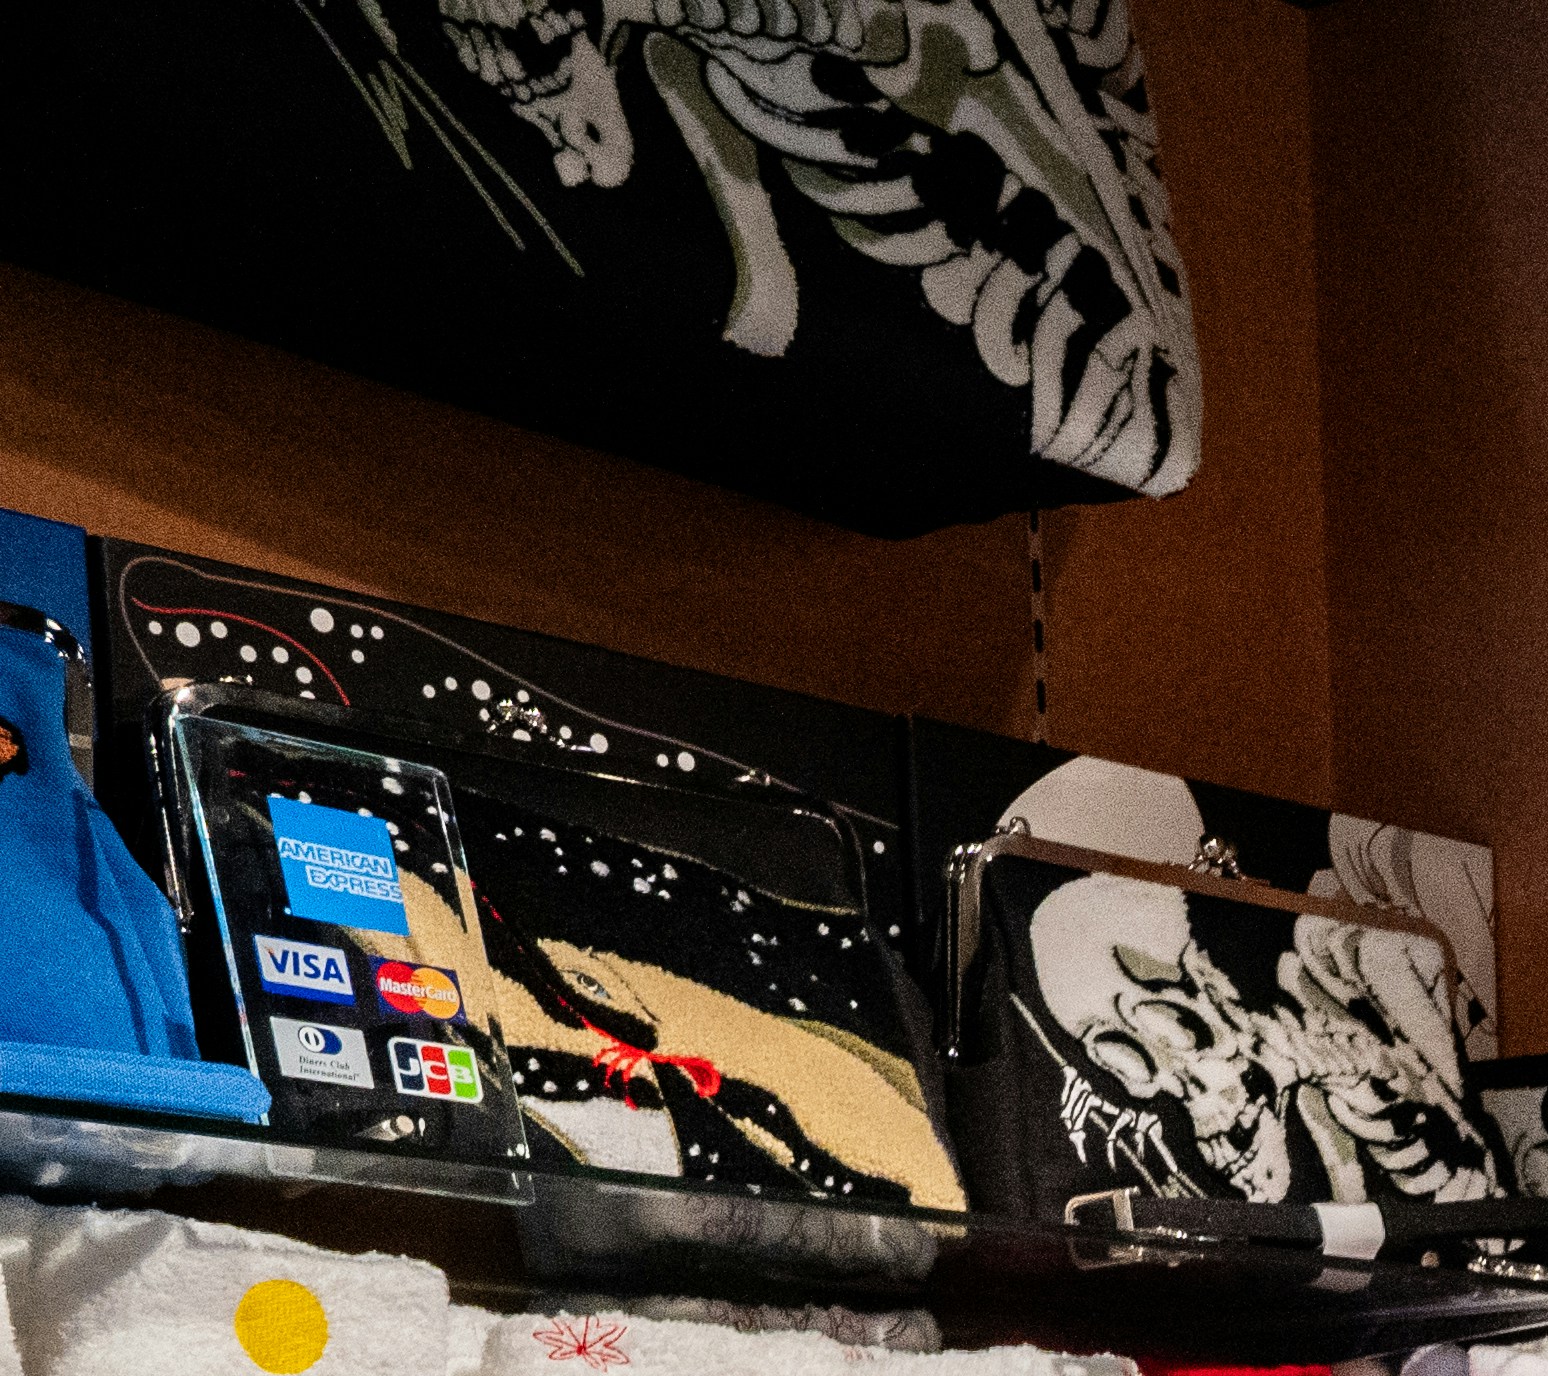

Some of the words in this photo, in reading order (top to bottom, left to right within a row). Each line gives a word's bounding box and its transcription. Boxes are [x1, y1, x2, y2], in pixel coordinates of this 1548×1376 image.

[278, 837, 393, 879] AMERICAN
[305, 865, 404, 905] EXPRESS
[264, 946, 346, 984] VISA
[379, 977, 458, 1002] MasterCard
[299, 1055, 326, 1068] Diners
[330, 1059, 351, 1071] Club
[398, 1057, 473, 1085] JCB
